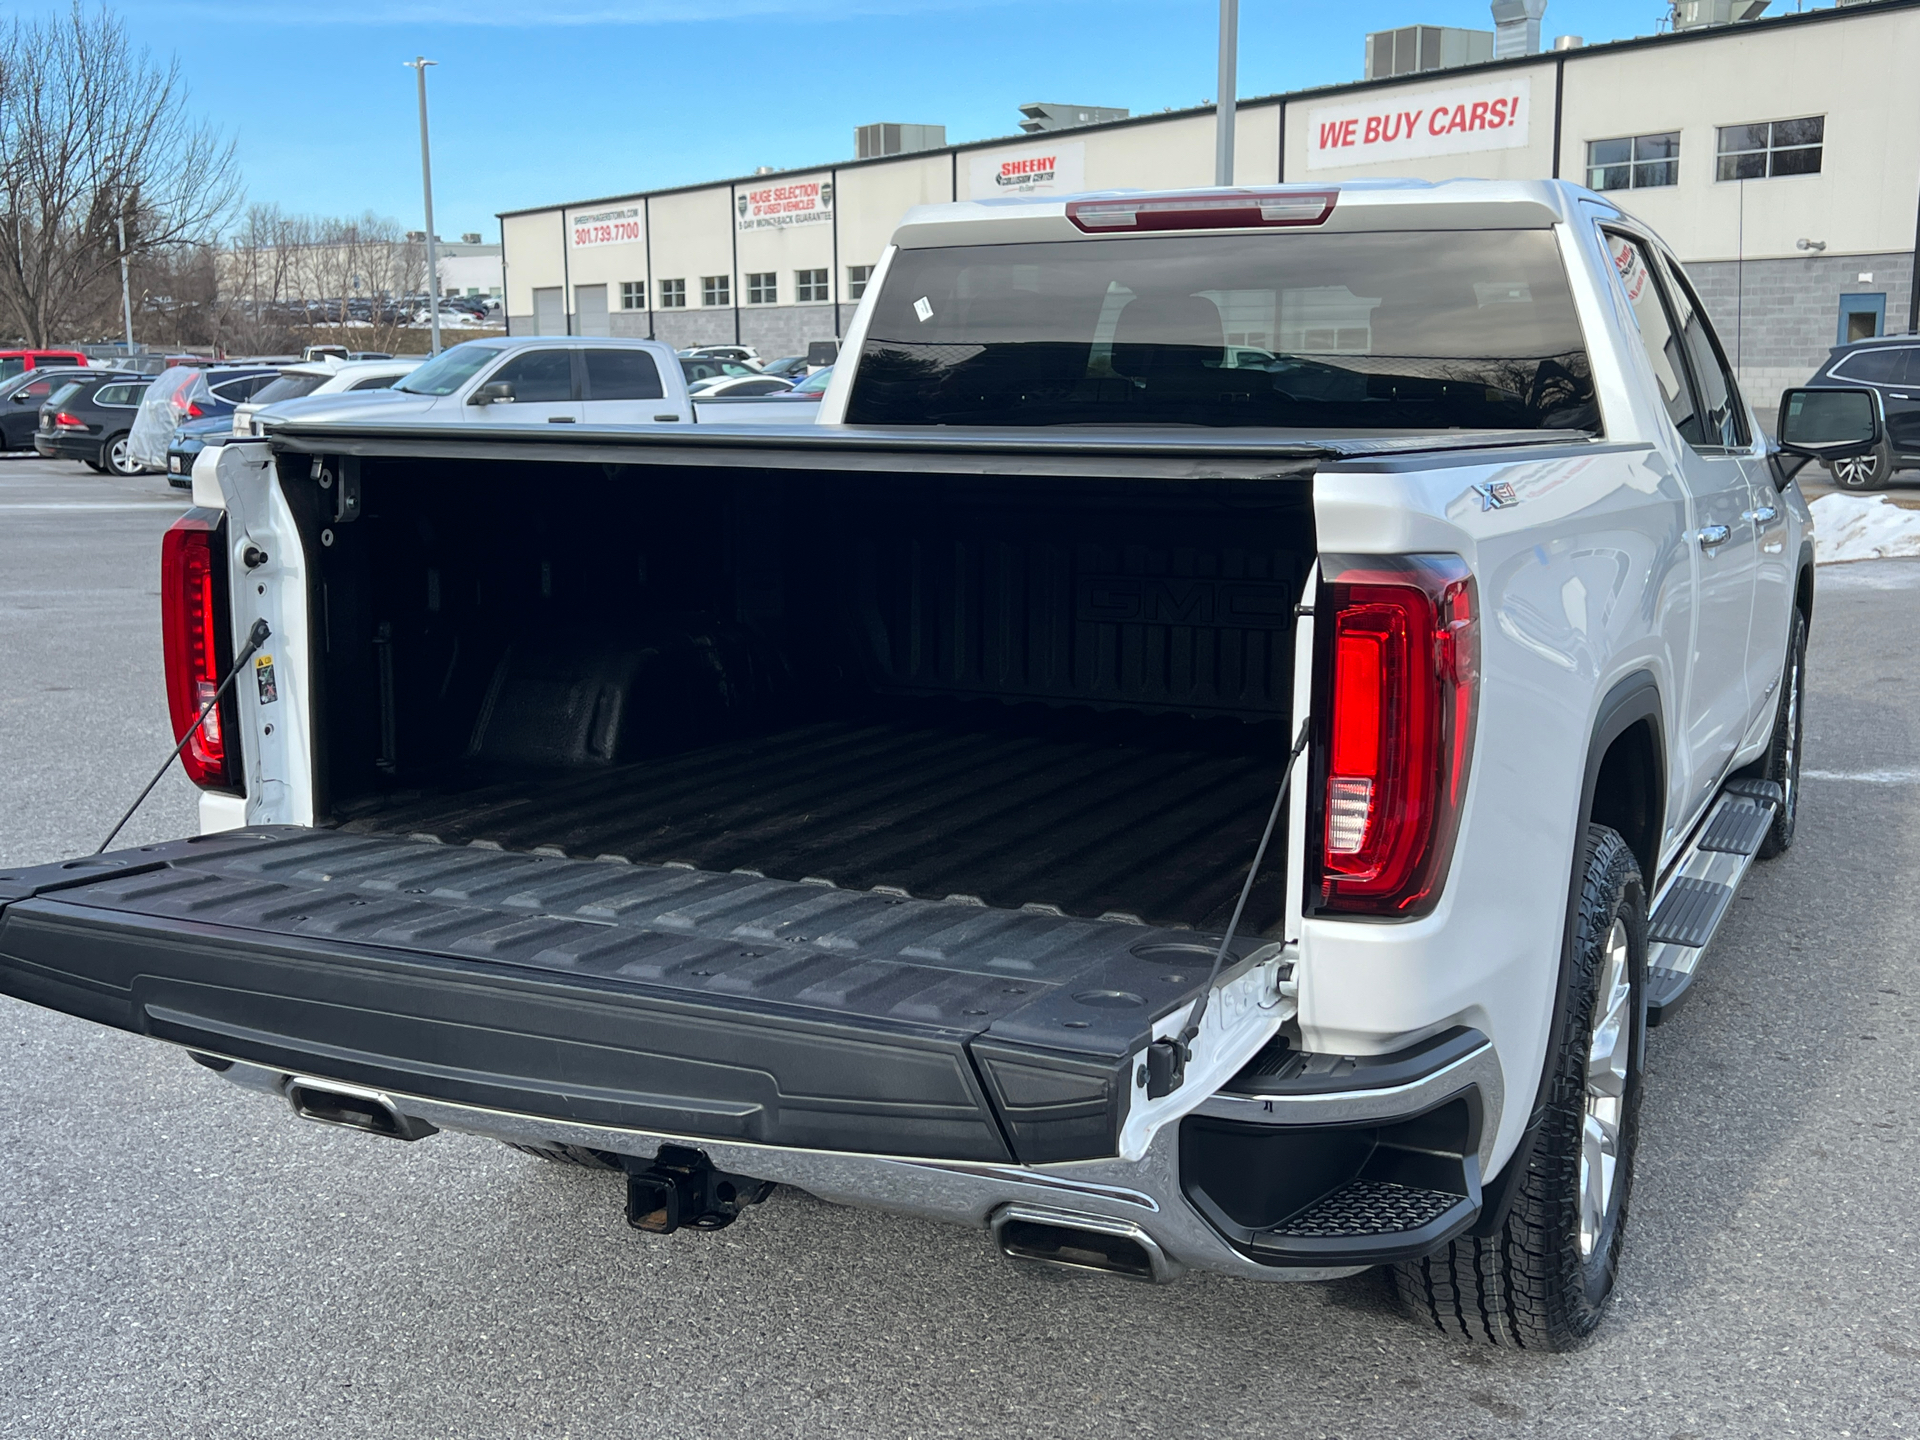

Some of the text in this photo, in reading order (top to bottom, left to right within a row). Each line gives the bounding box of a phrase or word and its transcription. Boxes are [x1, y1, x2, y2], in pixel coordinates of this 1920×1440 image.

[1319, 96, 1520, 150] WE BUY CARS!
[1002, 156, 1056, 176] SHEEHY
[750, 190, 772, 204] HUGE
[774, 183, 819, 201] SELECTION
[753, 205, 762, 216] OF
[763, 203, 782, 215] USED
[783, 198, 816, 213] VEHICLES
[795, 211, 832, 223] GUARANTEE
[575, 221, 640, 245] 301.739.7700
[1079, 578, 1285, 626] GMC
